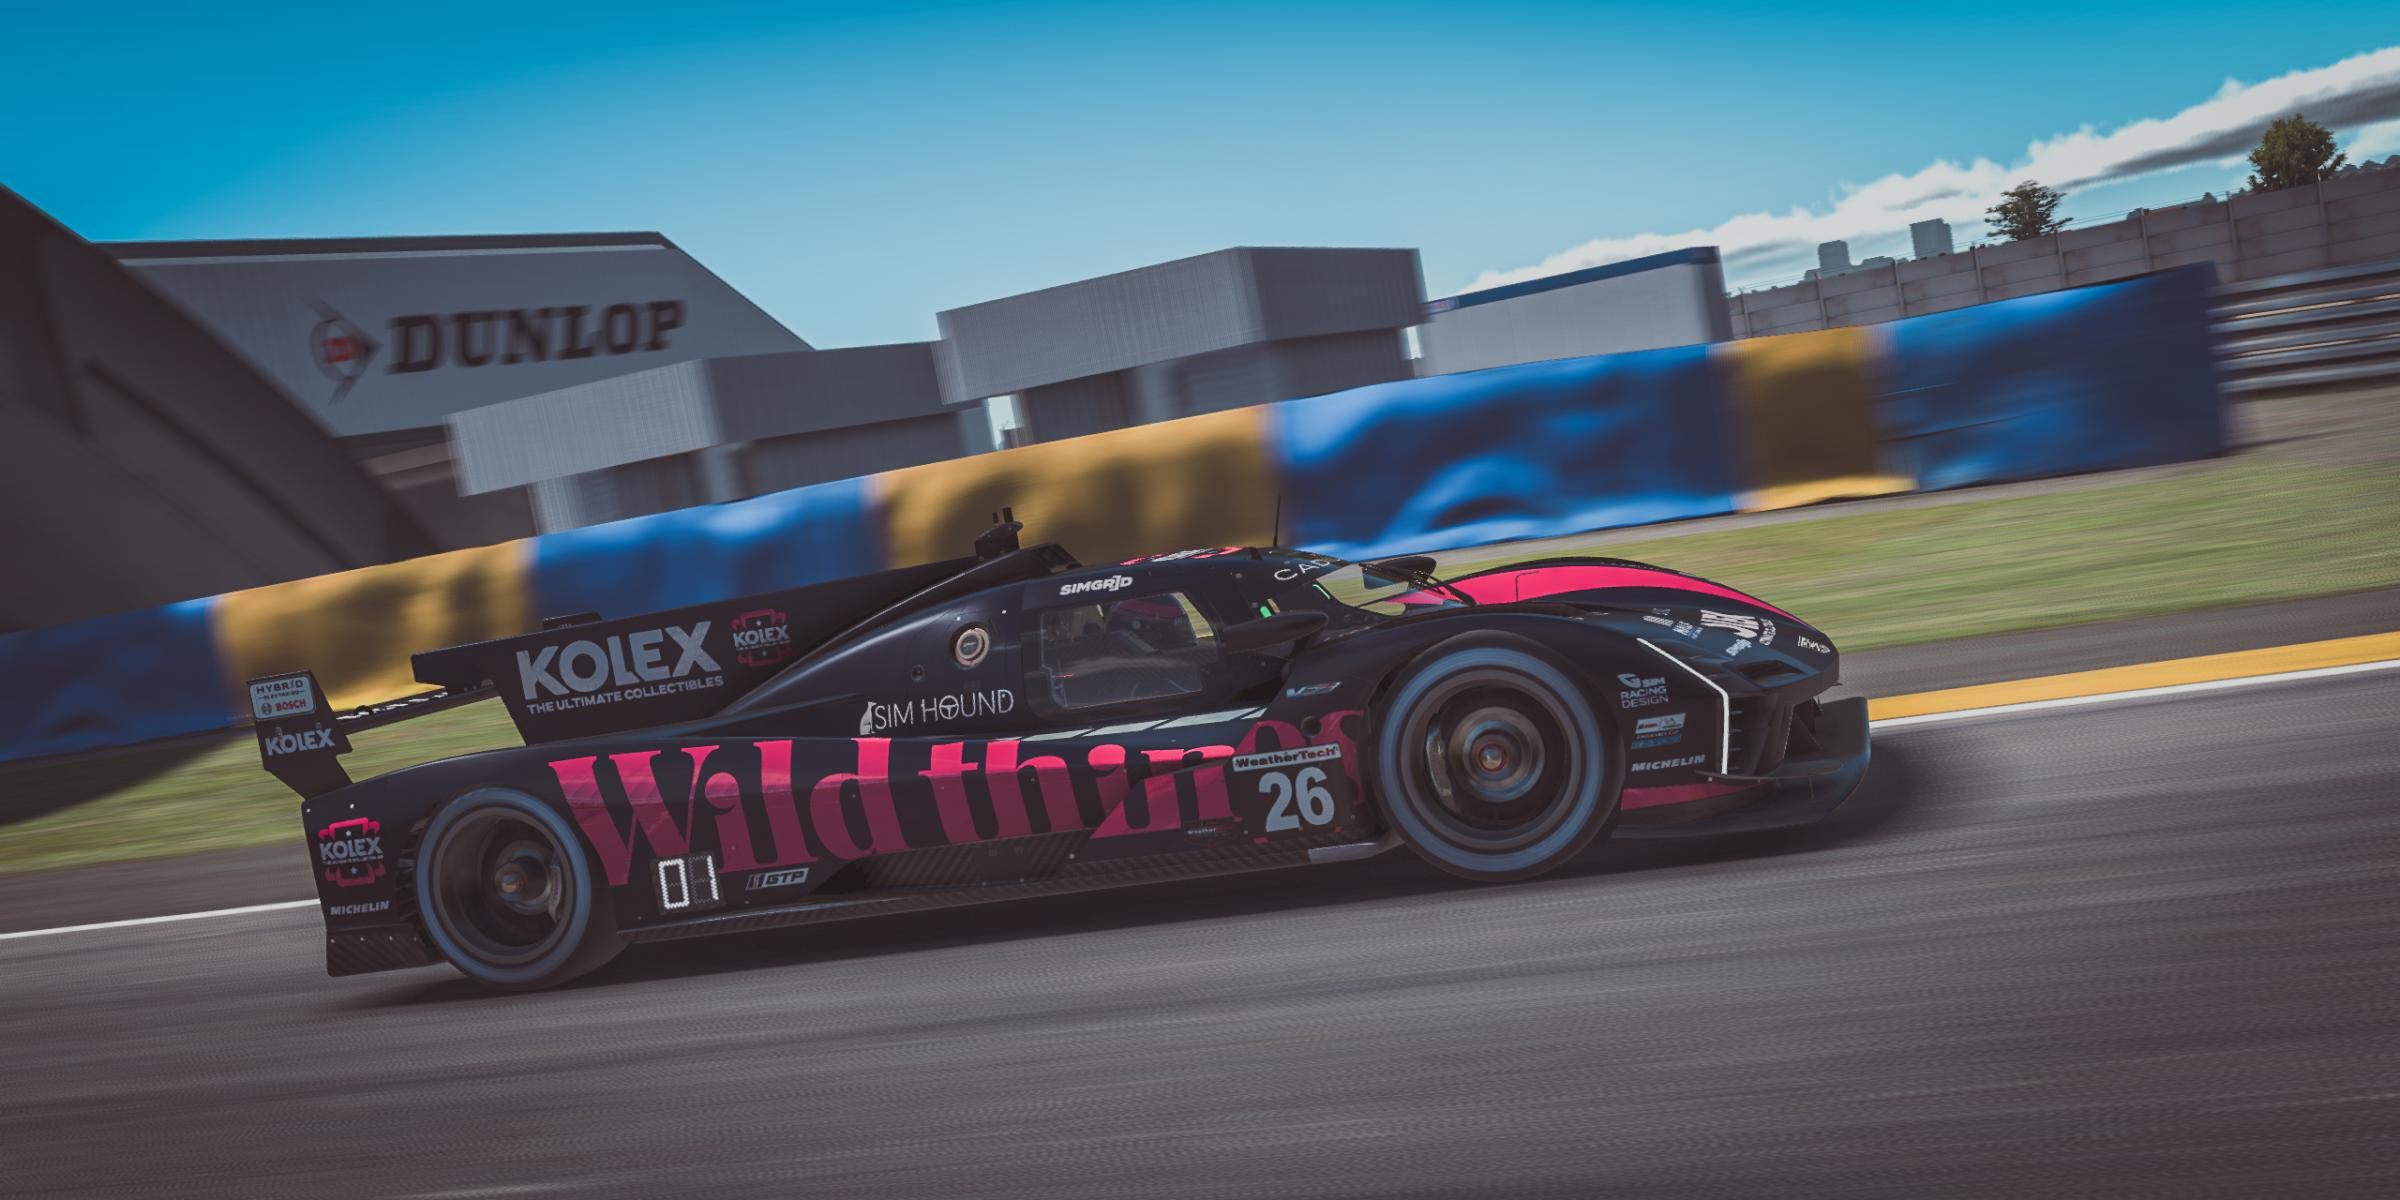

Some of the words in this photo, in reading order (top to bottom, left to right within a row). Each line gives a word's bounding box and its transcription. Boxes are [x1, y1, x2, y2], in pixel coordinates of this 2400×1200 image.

[385, 299, 687, 375] DUNLOP
[733, 624, 790, 648] KOLEX
[516, 620, 721, 700] KOLEX
[526, 700, 554, 715] THE
[558, 691, 623, 711] ULTIMATE
[624, 675, 724, 700] COLLECTIBLES
[1621, 686, 1667, 699] RACING
[1622, 696, 1669, 709] DESIGN
[275, 700, 306, 712] BOSCH
[874, 701, 915, 730] SIM
[921, 689, 1014, 723] HOUND
[264, 728, 336, 757] KOLEX
[1632, 754, 1706, 773] MICHELIN
[548, 737, 911, 887] Wild
[1259, 767, 1335, 833] 26
[320, 837, 384, 861] KOLEX
[658, 855, 719, 910] 01
[766, 871, 803, 886] GTP
[330, 900, 390, 916] MICHELIN
